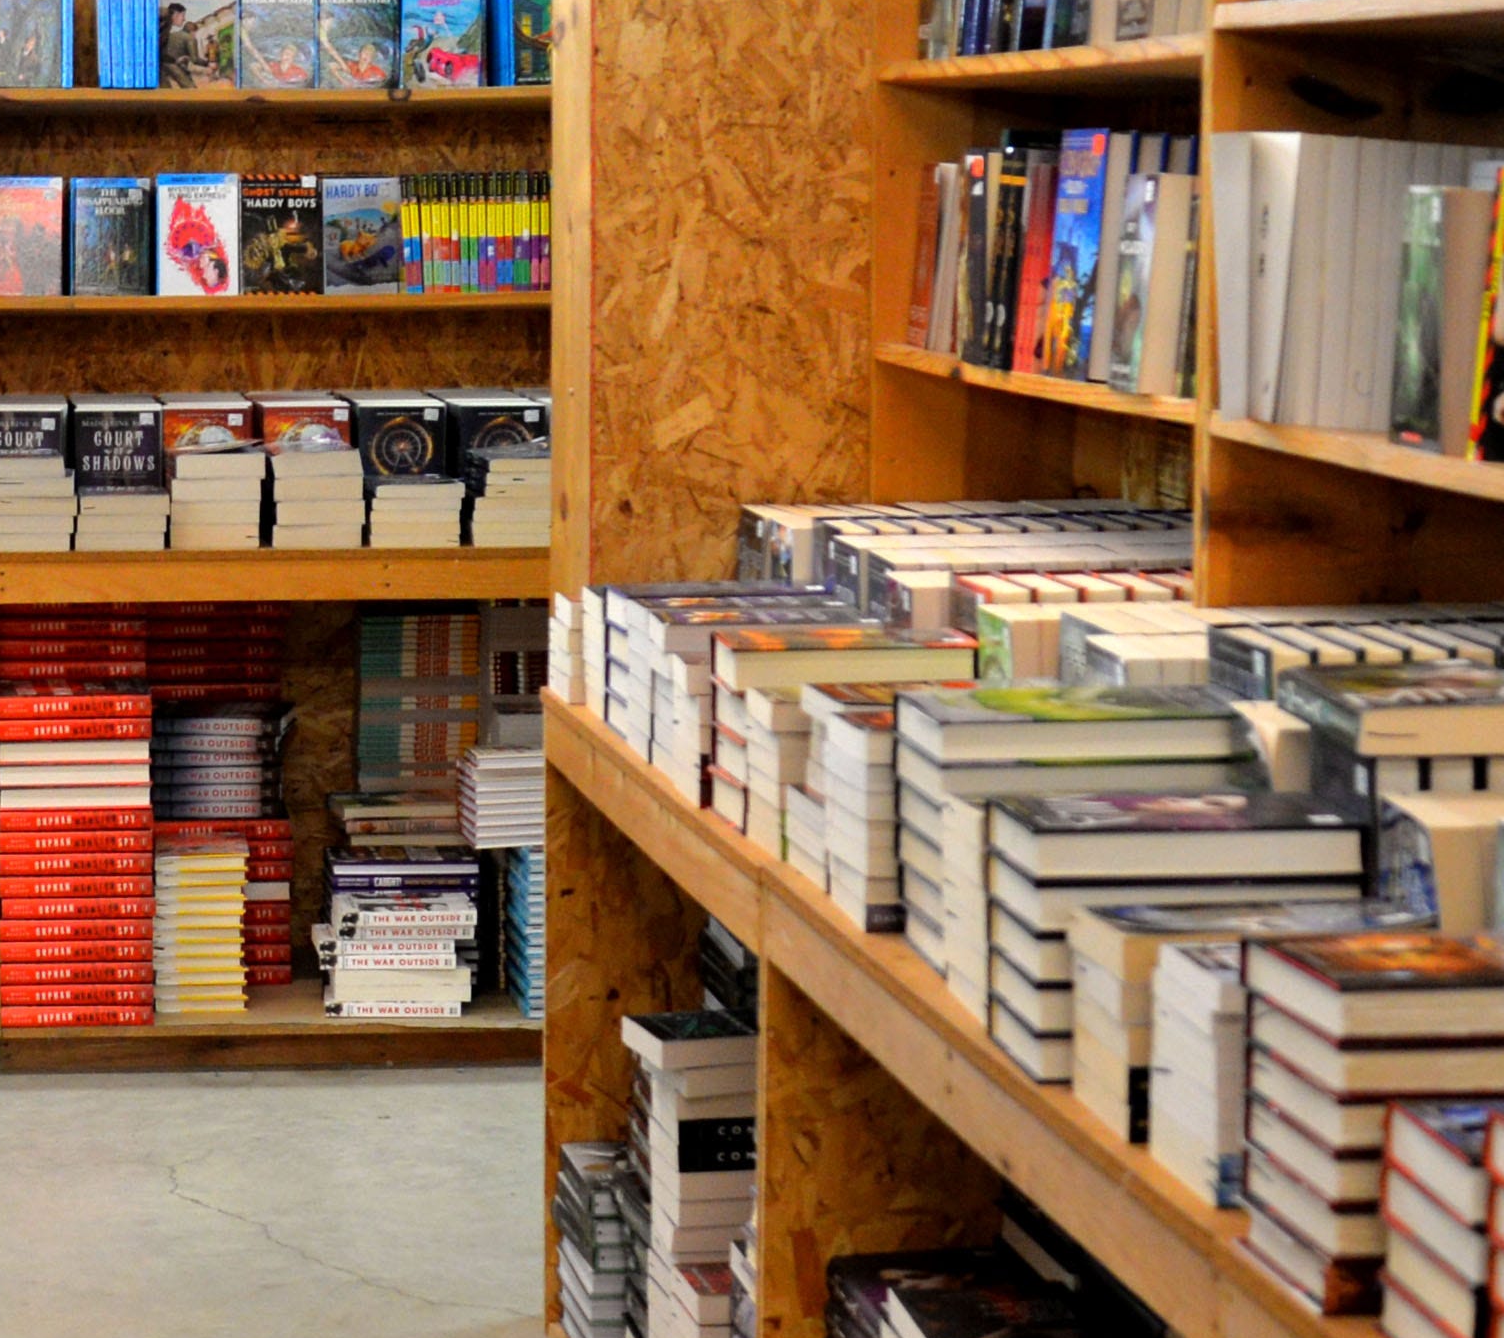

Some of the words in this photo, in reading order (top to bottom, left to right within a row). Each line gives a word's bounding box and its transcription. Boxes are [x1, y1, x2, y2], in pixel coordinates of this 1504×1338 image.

[242, 188, 275, 197] GHOST
[277, 188, 316, 197] STORIES
[325, 184, 362, 200] HARDY
[246, 199, 285, 209] HARDY
[287, 198, 316, 209] BOYS
[93, 430, 144, 446] COURT
[82, 454, 156, 472] SHADOWS
[32, 701, 70, 713] ORPHAN
[115, 700, 134, 711] SPY
[33, 724, 71, 737] ORPHAN
[116, 723, 134, 735] SPY
[212, 722, 258, 732] OUTSIDE
[207, 739, 252, 749] OUTSIDE
[35, 815, 72, 827] ORPHAN
[118, 814, 136, 825] SPY
[35, 836, 72, 848] ORPHAN
[117, 835, 135, 847] SPY
[34, 857, 71, 870] ORPHAN
[116, 857, 134, 869] SPY
[372, 913, 391, 923] THE
[394, 913, 417, 923] WAR
[420, 913, 462, 923] OUTSIDE
[370, 928, 388, 937] THE
[392, 928, 413, 937] WAR
[417, 928, 459, 937] OUTSIDE
[350, 942, 369, 951] THE
[372, 942, 394, 951] WAR
[397, 942, 439, 951] OUTSIDE
[351, 958, 370, 967] THE
[373, 958, 395, 967] WAR
[399, 958, 440, 967] OUTSIDE
[356, 1006, 374, 1015] THE
[378, 1006, 400, 1015] WAR
[404, 1006, 445, 1015] OUTSIDE
